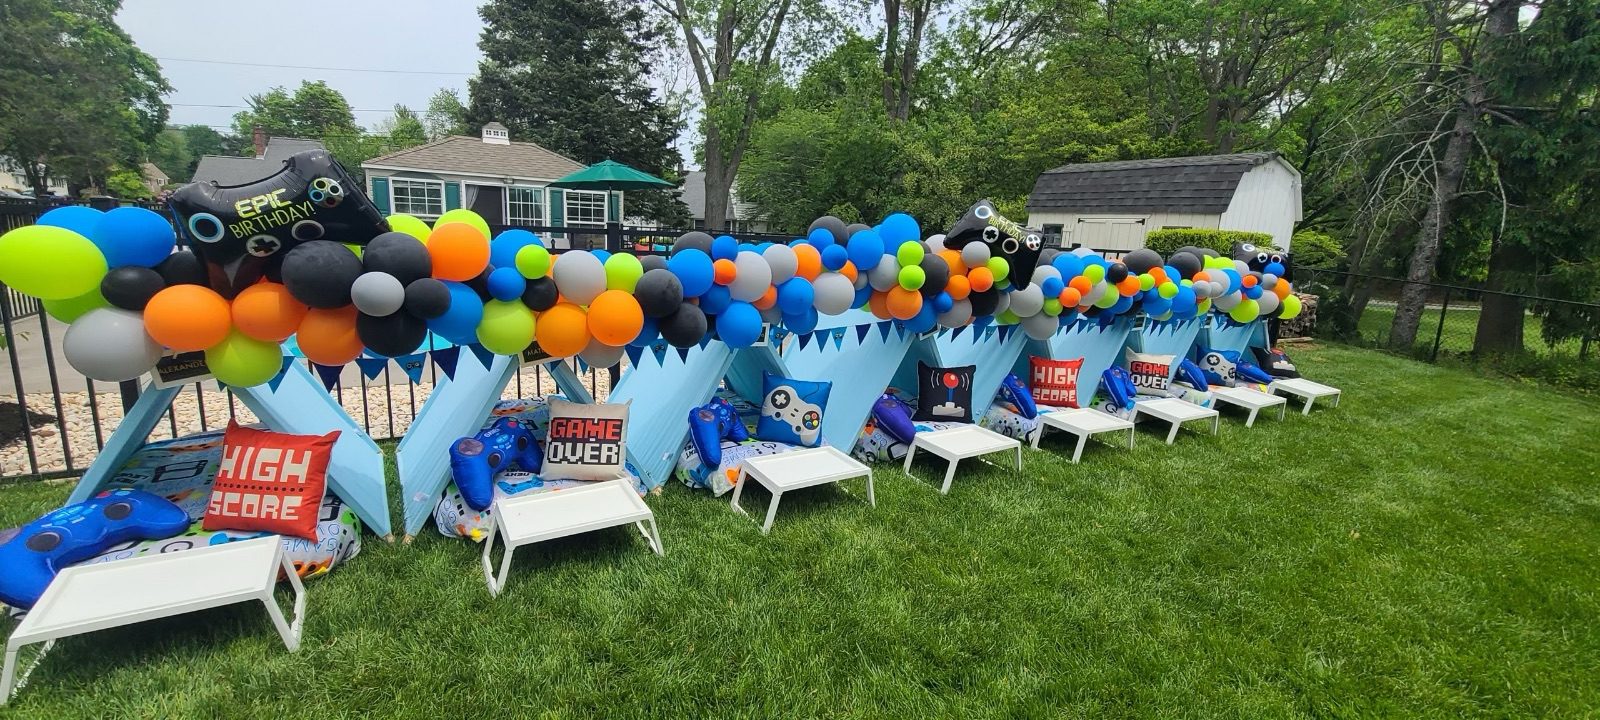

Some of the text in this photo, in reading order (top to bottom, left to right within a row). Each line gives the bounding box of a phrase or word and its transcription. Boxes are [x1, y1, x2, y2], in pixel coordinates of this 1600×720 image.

[235, 188, 292, 218] EPIC
[229, 200, 317, 239] BIRTHDAY!
[1034, 366, 1079, 385] HIGH
[1032, 387, 1076, 402] SCORE
[551, 419, 622, 440] GAME
[218, 444, 312, 484] HIGH
[548, 441, 619, 464] OVER
[208, 490, 303, 520] SCORE
